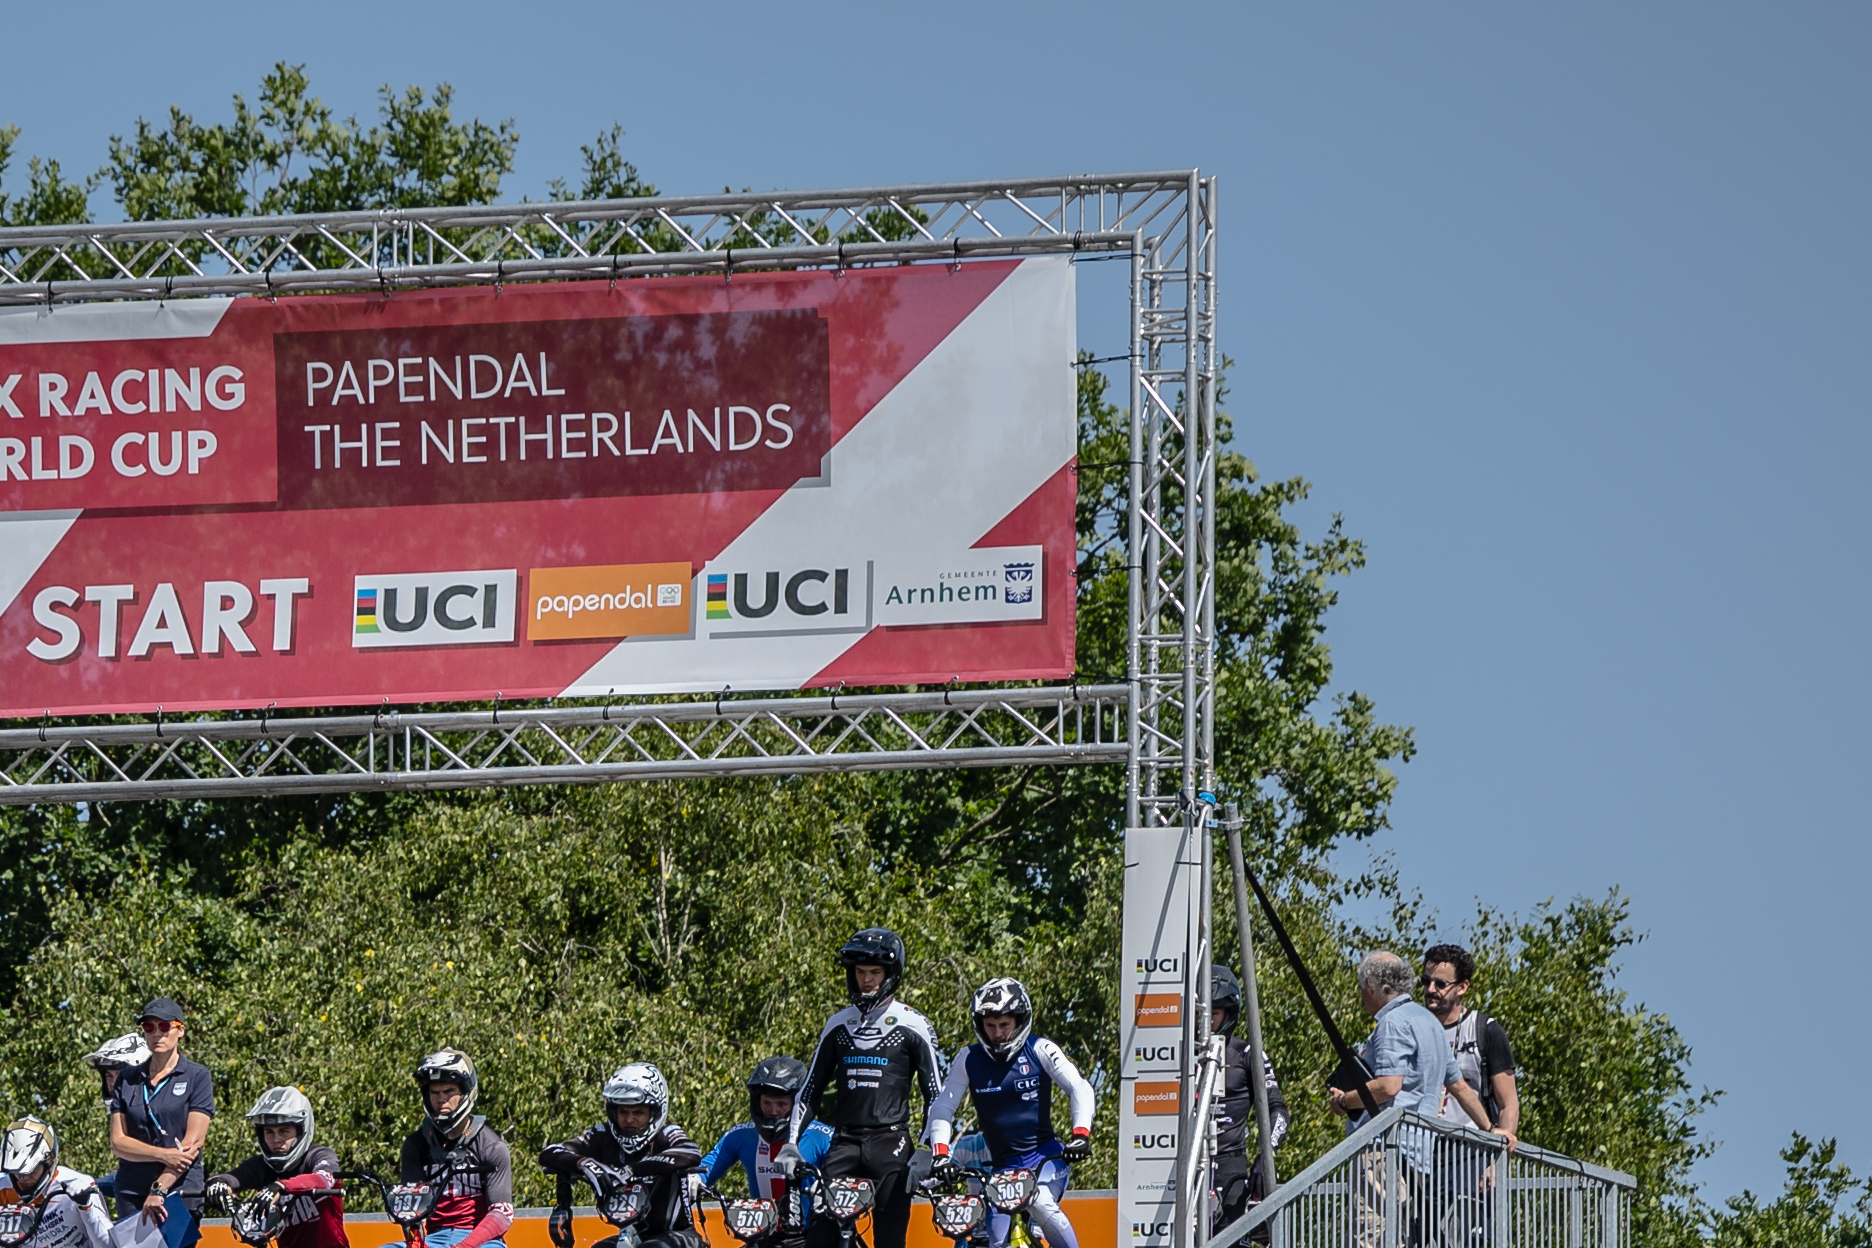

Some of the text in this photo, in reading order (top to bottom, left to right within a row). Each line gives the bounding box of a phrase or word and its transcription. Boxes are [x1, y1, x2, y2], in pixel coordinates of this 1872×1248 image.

[306, 351, 566, 407] PAPENDAL
[39, 365, 246, 417] RACING
[304, 403, 794, 469] THE NETHERLANDS
[111, 431, 218, 477] CUP
[939, 569, 998, 579] GEMEENTE
[733, 568, 849, 619] UCI
[885, 581, 998, 605] Arnhem
[383, 583, 498, 632] UCI
[536, 584, 653, 620] papendal
[26, 577, 310, 661] START
[1144, 958, 1178, 973] UCI
[1137, 1006, 1170, 1016] papendal
[842, 1055, 889, 1066] SHIMANO
[1142, 1046, 1175, 1062] UCI
[1136, 1092, 1169, 1103] papendal
[1141, 1134, 1175, 1149] UCI
[834, 1190, 859, 1208] 572
[997, 1183, 1024, 1200] 509
[736, 1210, 764, 1227] 570
[945, 1206, 973, 1223] 528
